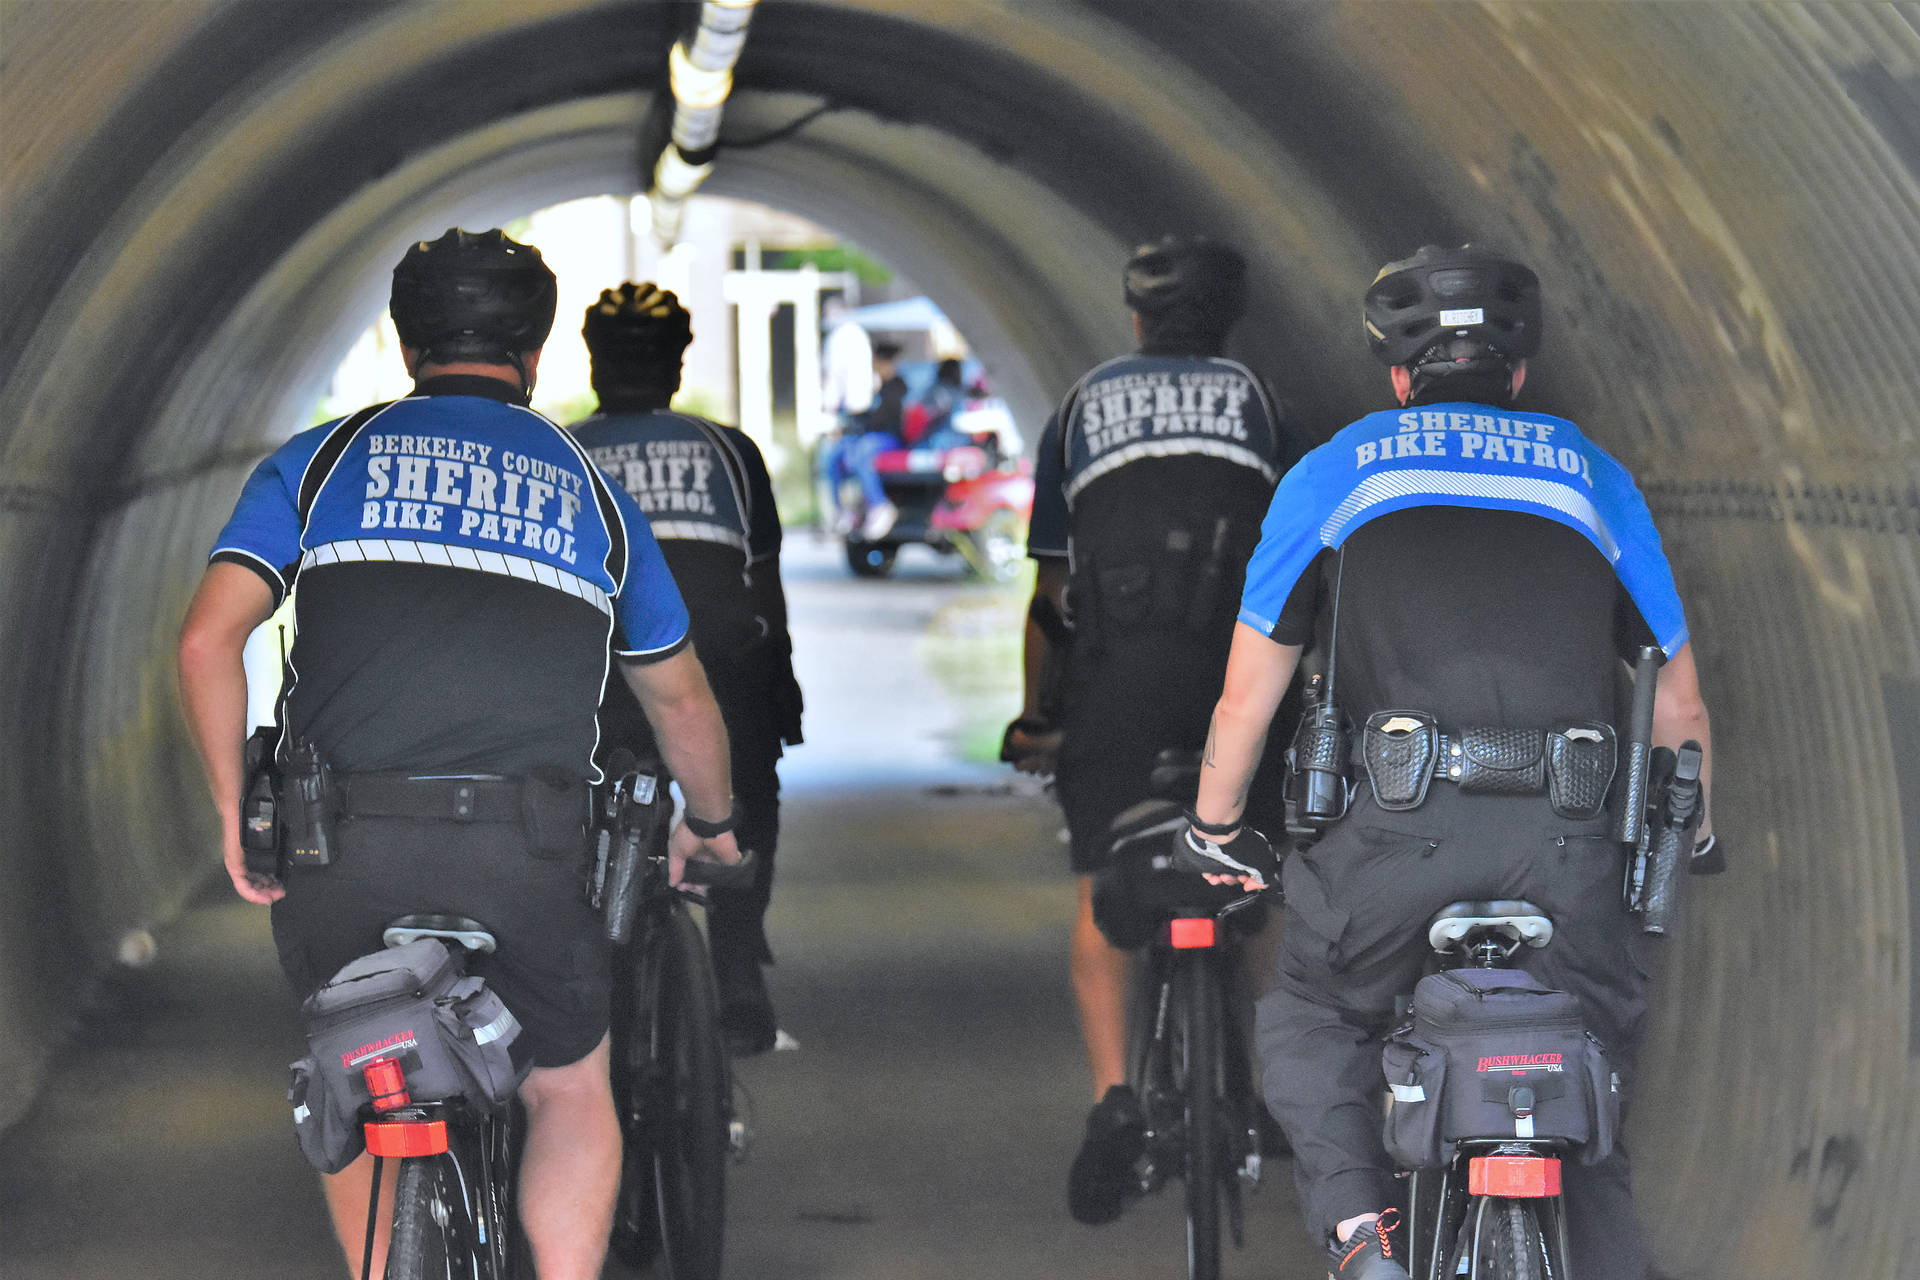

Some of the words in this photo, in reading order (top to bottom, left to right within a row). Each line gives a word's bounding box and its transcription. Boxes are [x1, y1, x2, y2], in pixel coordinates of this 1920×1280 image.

[1083, 385, 1249, 435] SHERIFF
[1152, 414, 1248, 441] PATROL
[1398, 412, 1555, 442] SHERIFF
[369, 435, 492, 466] BERKELEY
[502, 452, 582, 496] COUNTY
[1356, 432, 1446, 469] BIKE
[366, 456, 581, 532] SHERIFF
[631, 490, 716, 516] ATROL
[361, 501, 444, 531] BIKE
[459, 509, 577, 565] PATROL
[1547, 1064, 1563, 1072] USA
